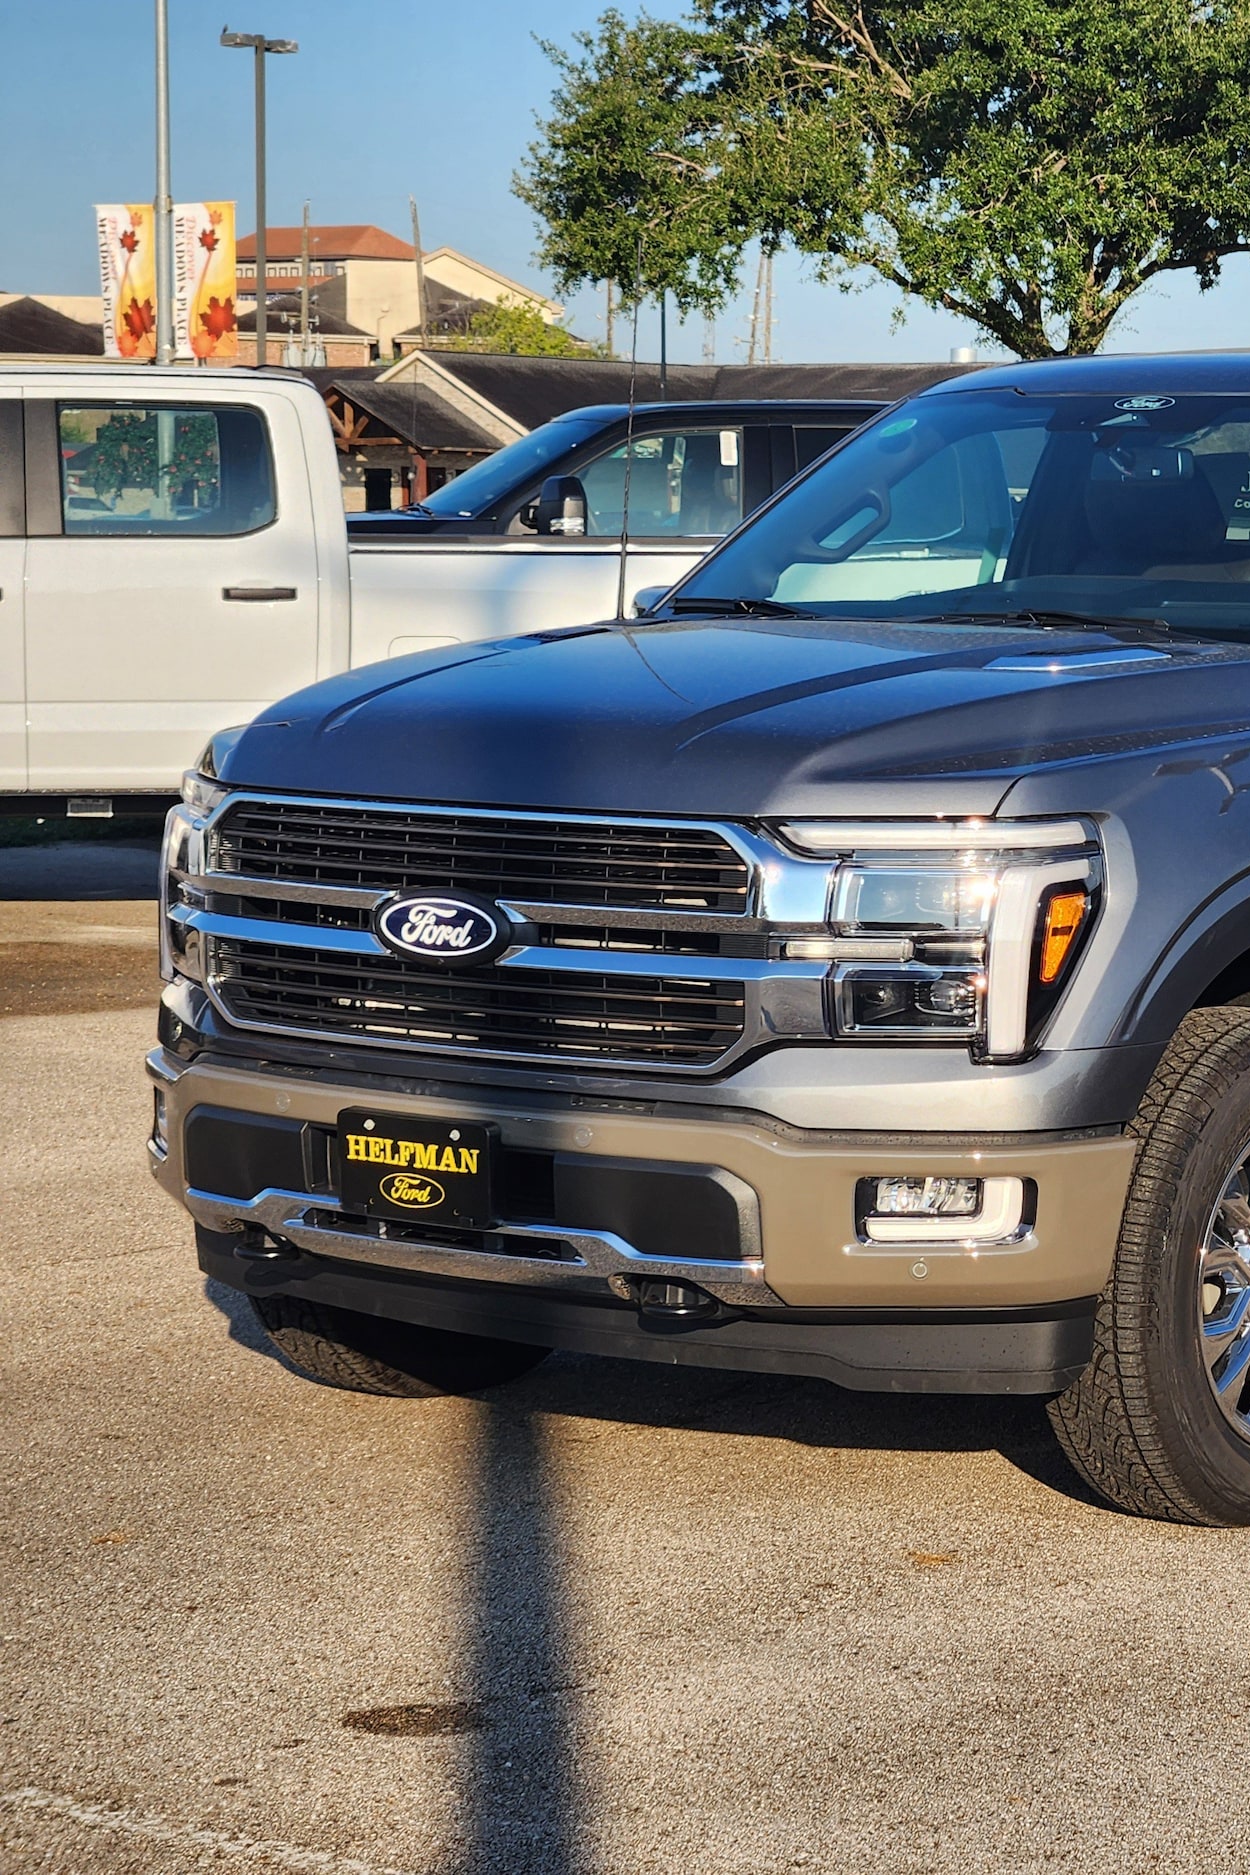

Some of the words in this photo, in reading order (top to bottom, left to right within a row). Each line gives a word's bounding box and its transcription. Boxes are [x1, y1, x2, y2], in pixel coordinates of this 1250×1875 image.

[98, 217, 111, 293] MEADOWS
[175, 217, 187, 293] MEADOWS
[103, 297, 115, 345] PLACE
[176, 297, 188, 345] PLACE
[401, 903, 475, 948] Ford
[346, 1134, 481, 1175] HELFMAN
[389, 1174, 433, 1203] Ford
